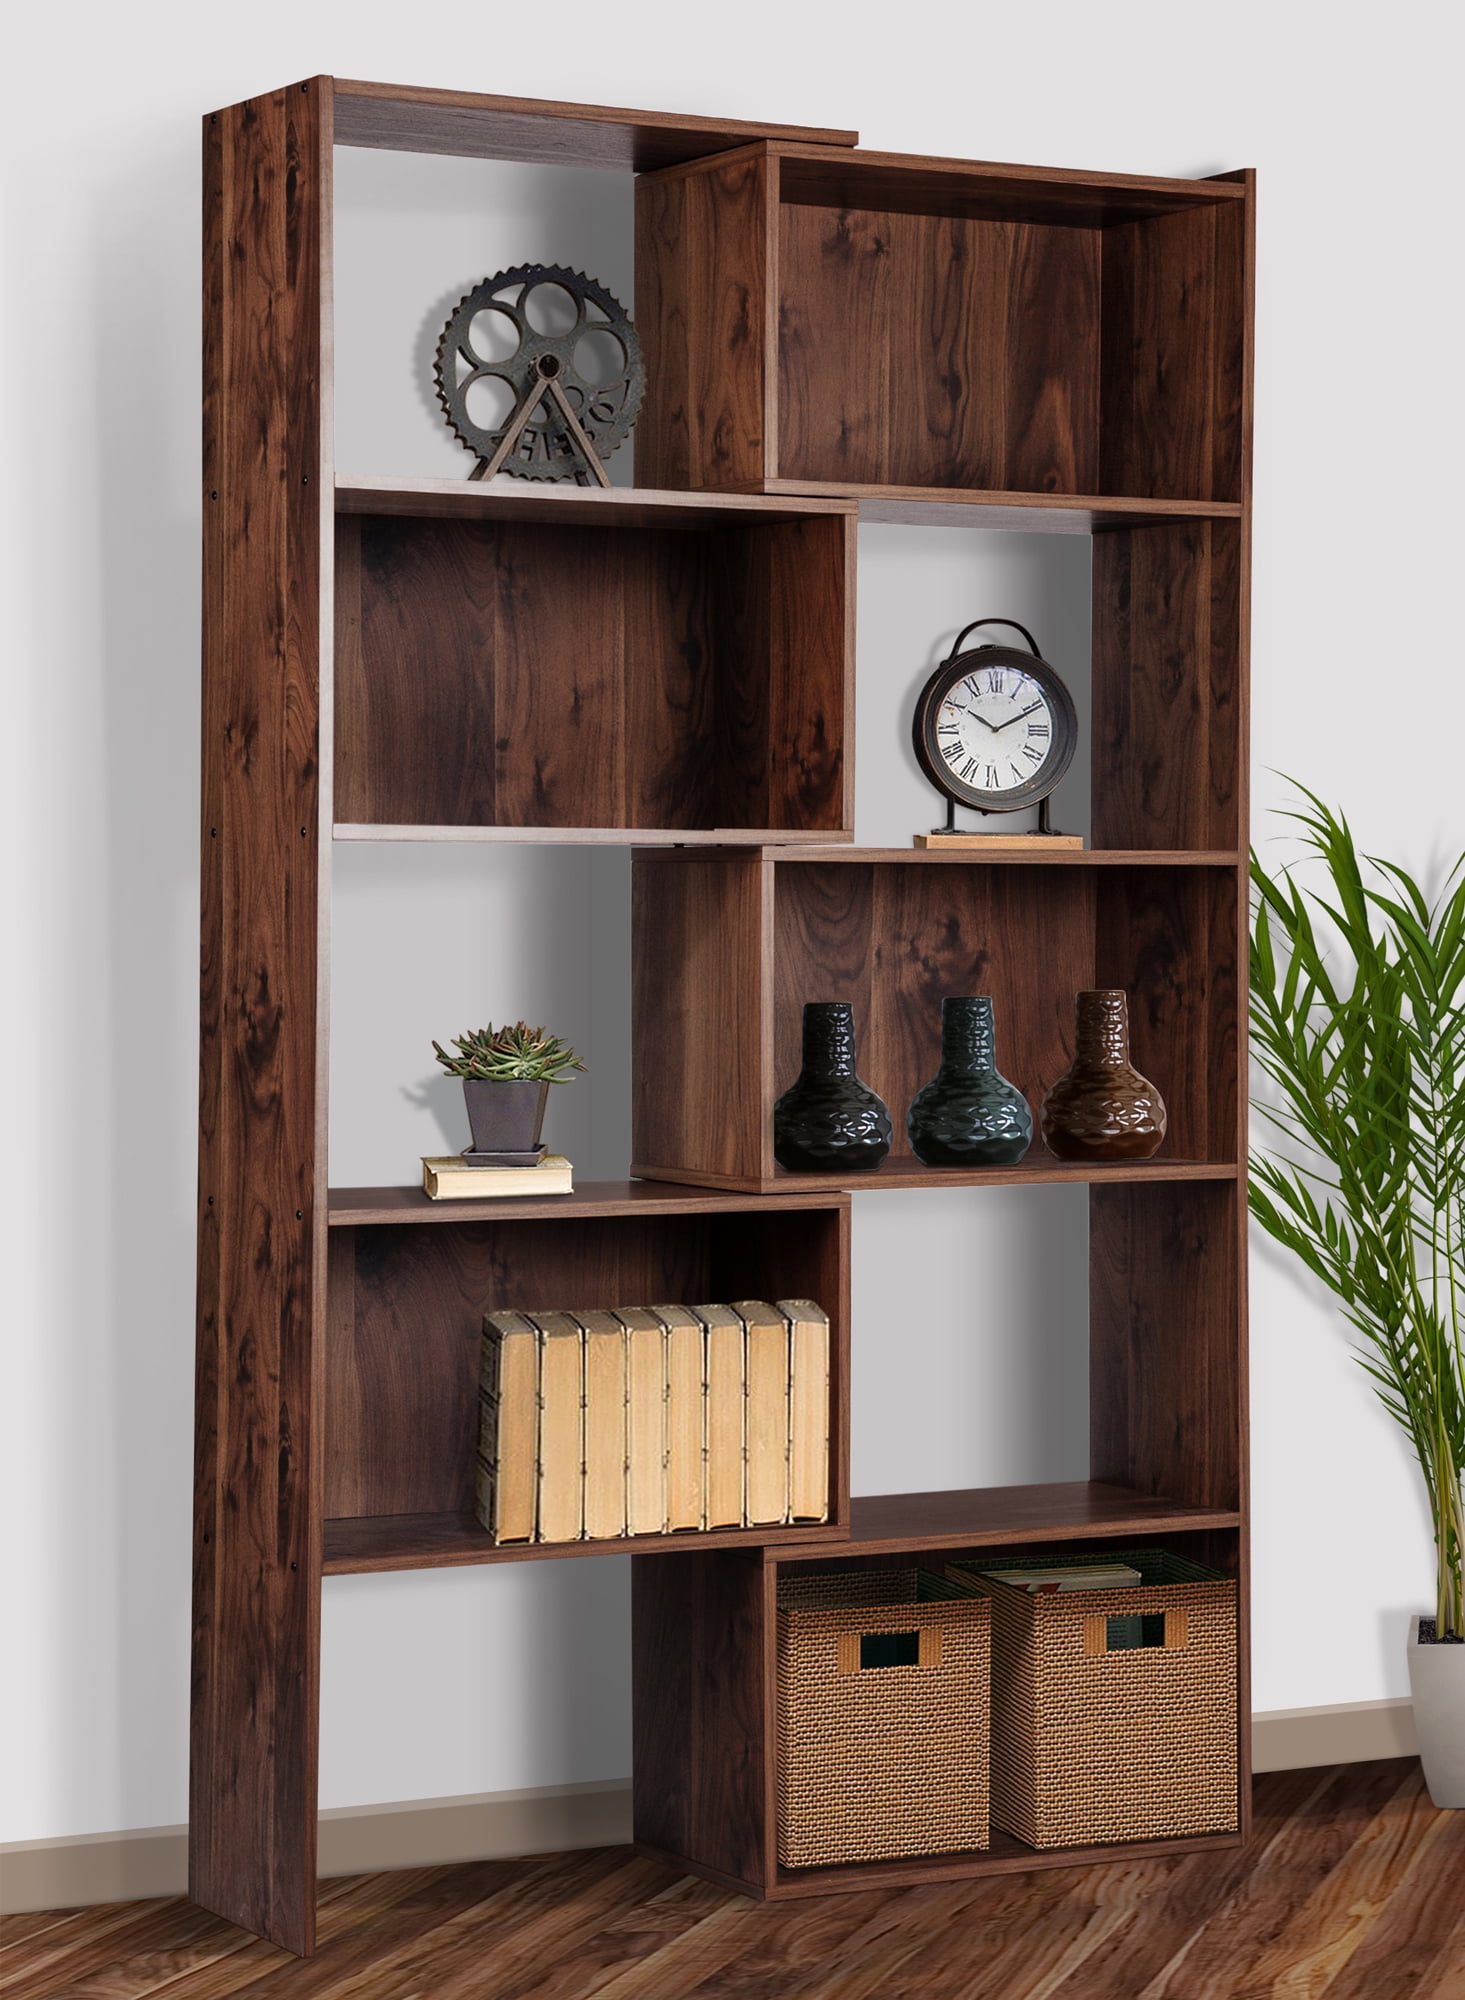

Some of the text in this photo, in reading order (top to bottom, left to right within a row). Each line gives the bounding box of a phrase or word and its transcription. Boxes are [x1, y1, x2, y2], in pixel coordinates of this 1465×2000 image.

[962, 674, 984, 701] XI
[986, 671, 1005, 694] XII
[1009, 678, 1025, 701] I
[1027, 722, 1049, 740] III
[959, 757, 980, 783] VII
[985, 764, 1001, 789] VI
[1008, 762, 1026, 784] V
